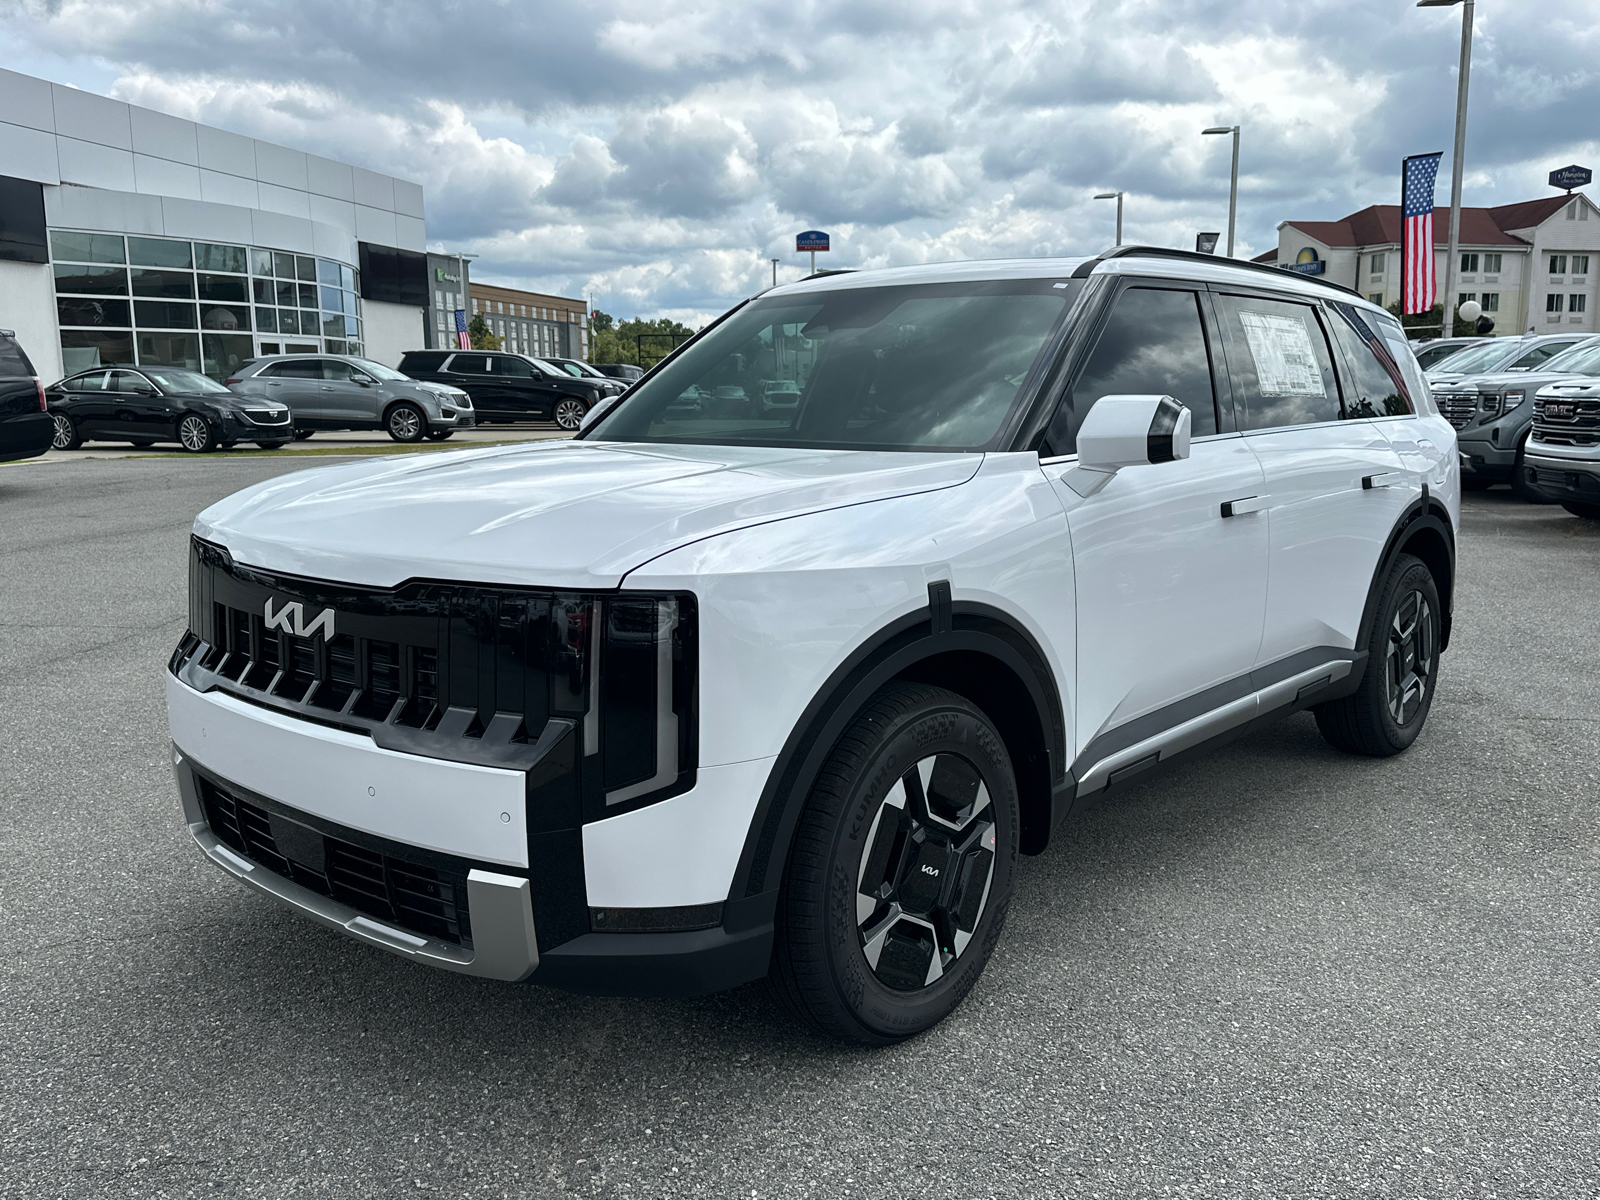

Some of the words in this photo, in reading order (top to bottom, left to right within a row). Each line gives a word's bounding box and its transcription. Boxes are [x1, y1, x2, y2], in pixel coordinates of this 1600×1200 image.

[1558, 171, 1588, 179] Hampton
[1545, 404, 1574, 417] GMC
[264, 596, 335, 643] KIA
[848, 753, 898, 841] KUMHO
[921, 864, 940, 878] KIA
